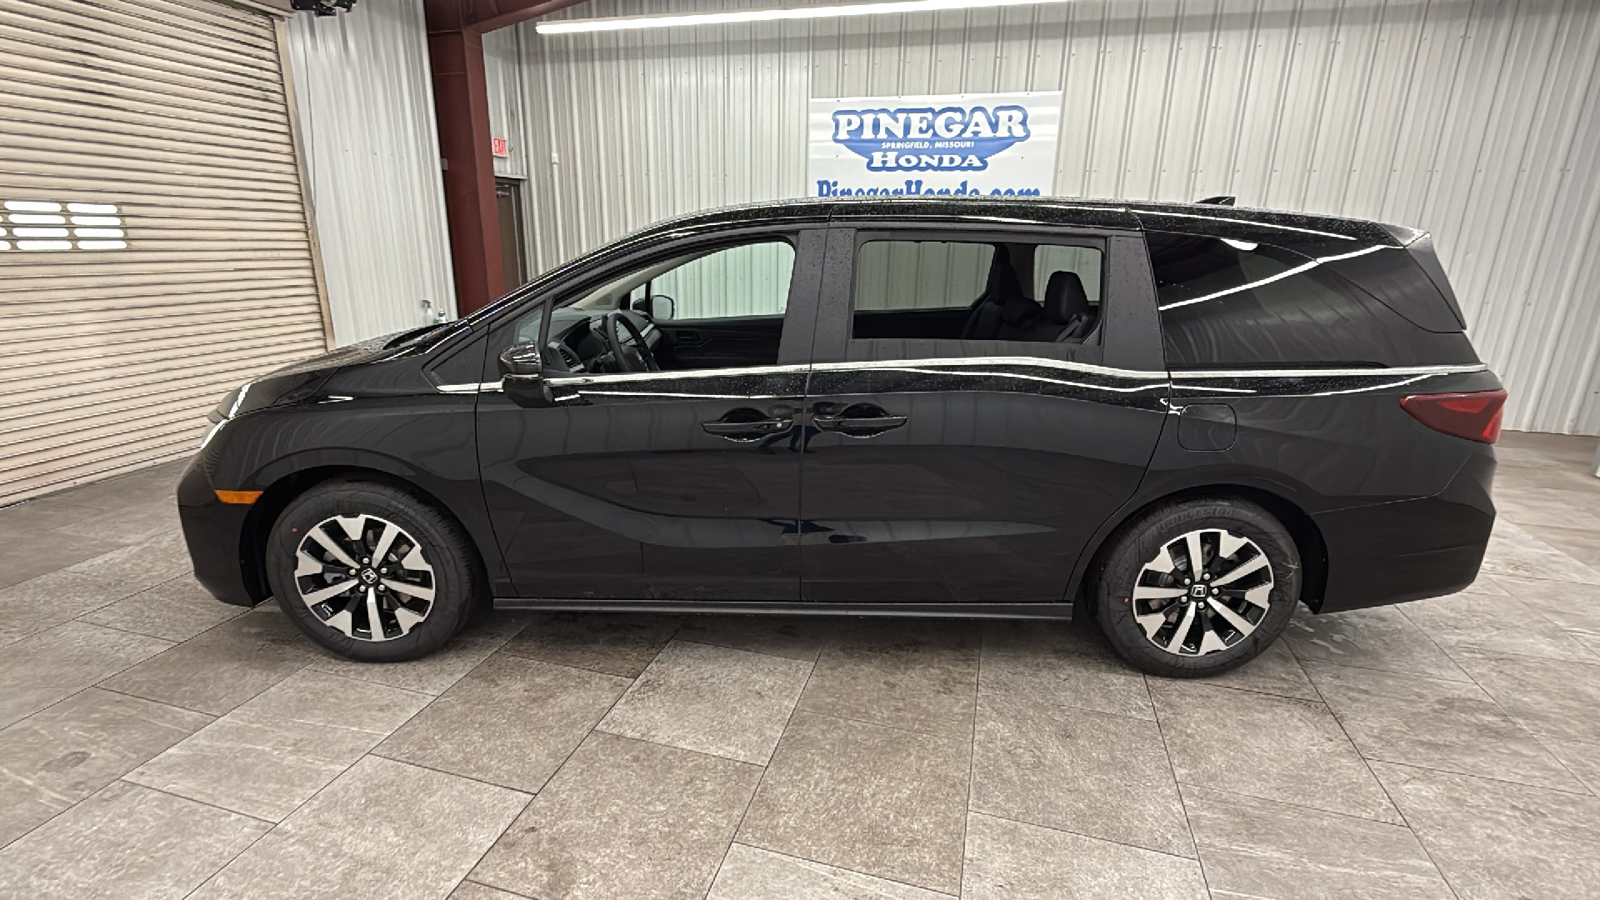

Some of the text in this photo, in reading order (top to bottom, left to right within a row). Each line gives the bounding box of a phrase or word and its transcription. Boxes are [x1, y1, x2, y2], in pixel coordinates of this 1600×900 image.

[834, 113, 1027, 140] PINEGAR
[493, 138, 507, 155] EXIT
[881, 141, 974, 149] SPRINGFIELD, MISSOURI
[870, 151, 984, 168] HONDA
